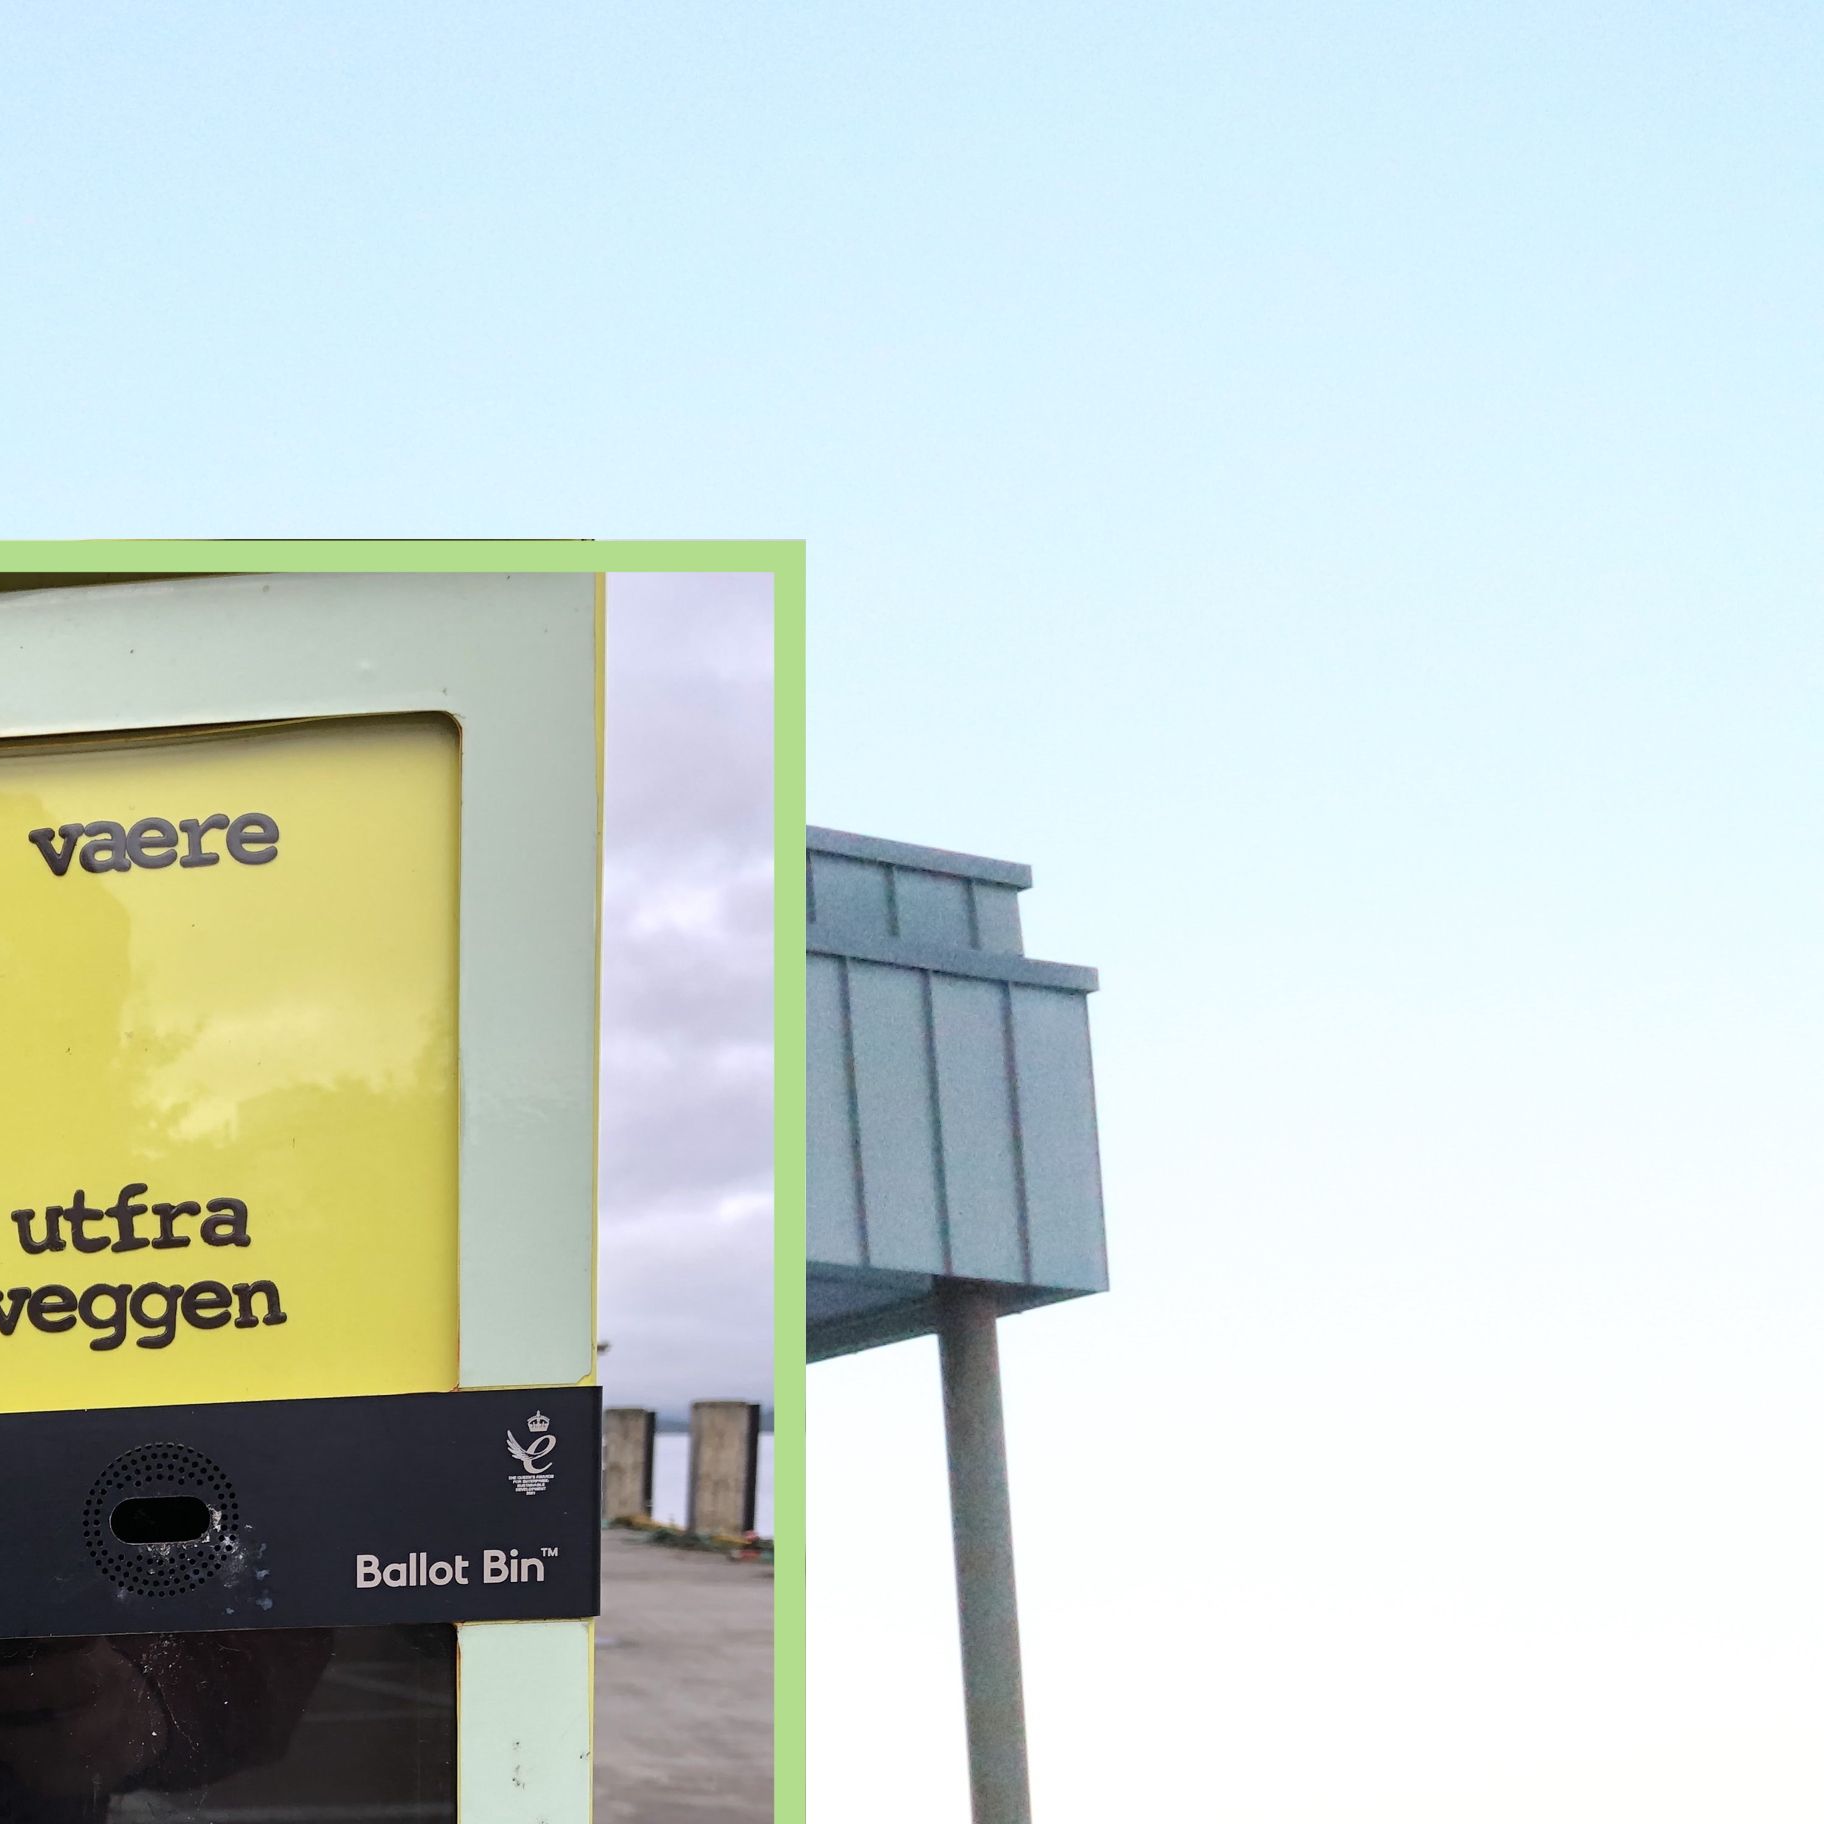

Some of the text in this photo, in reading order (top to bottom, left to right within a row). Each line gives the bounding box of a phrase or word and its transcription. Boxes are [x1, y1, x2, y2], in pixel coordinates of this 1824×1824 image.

[28, 812, 281, 877] vaere
[10, 1182, 252, 1255] utfra
[356, 1552, 469, 1589] Ballot
